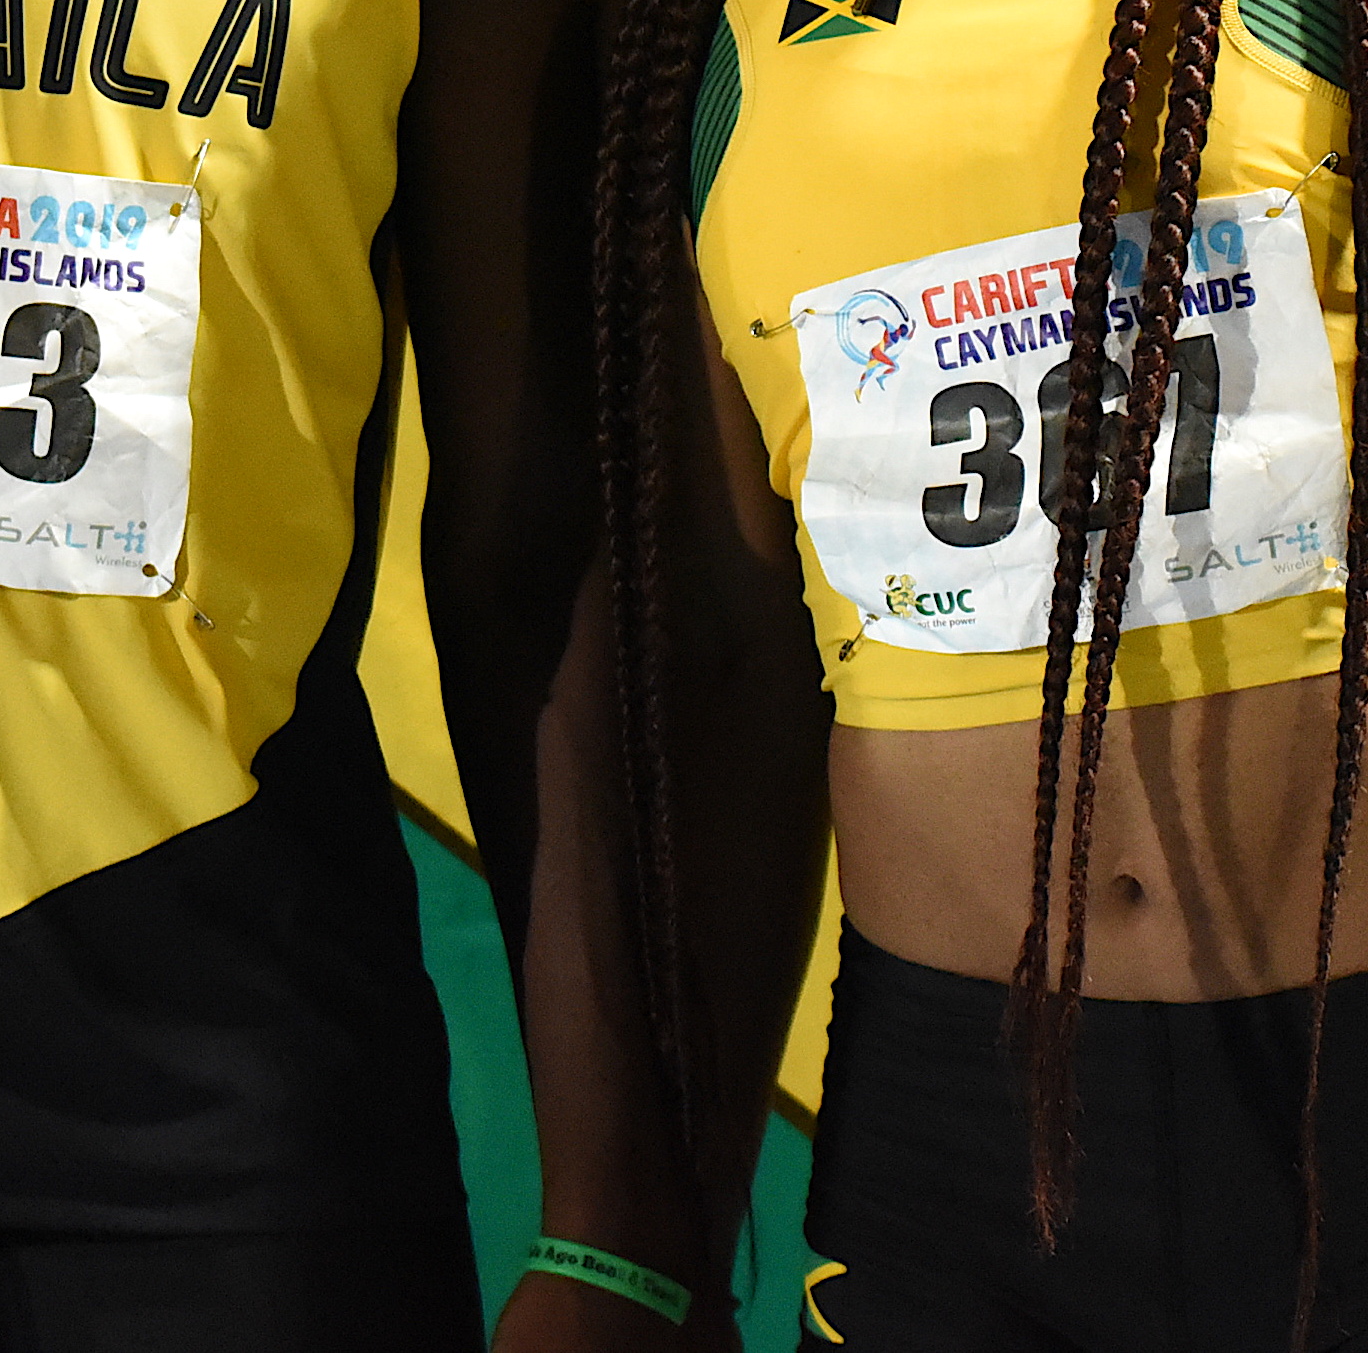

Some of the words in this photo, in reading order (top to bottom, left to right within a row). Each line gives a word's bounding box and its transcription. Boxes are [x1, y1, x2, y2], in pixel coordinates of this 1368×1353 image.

[28, 195, 148, 250] 2019
[921, 256, 1111, 330] CARIFT
[1111, 220, 1245, 288] 219
[95, 555, 143, 568] Wireless
[1274, 557, 1317, 574] Wirele
[915, 589, 976, 616] CUC
[933, 619, 947, 628] the
[949, 618, 976, 629] power
